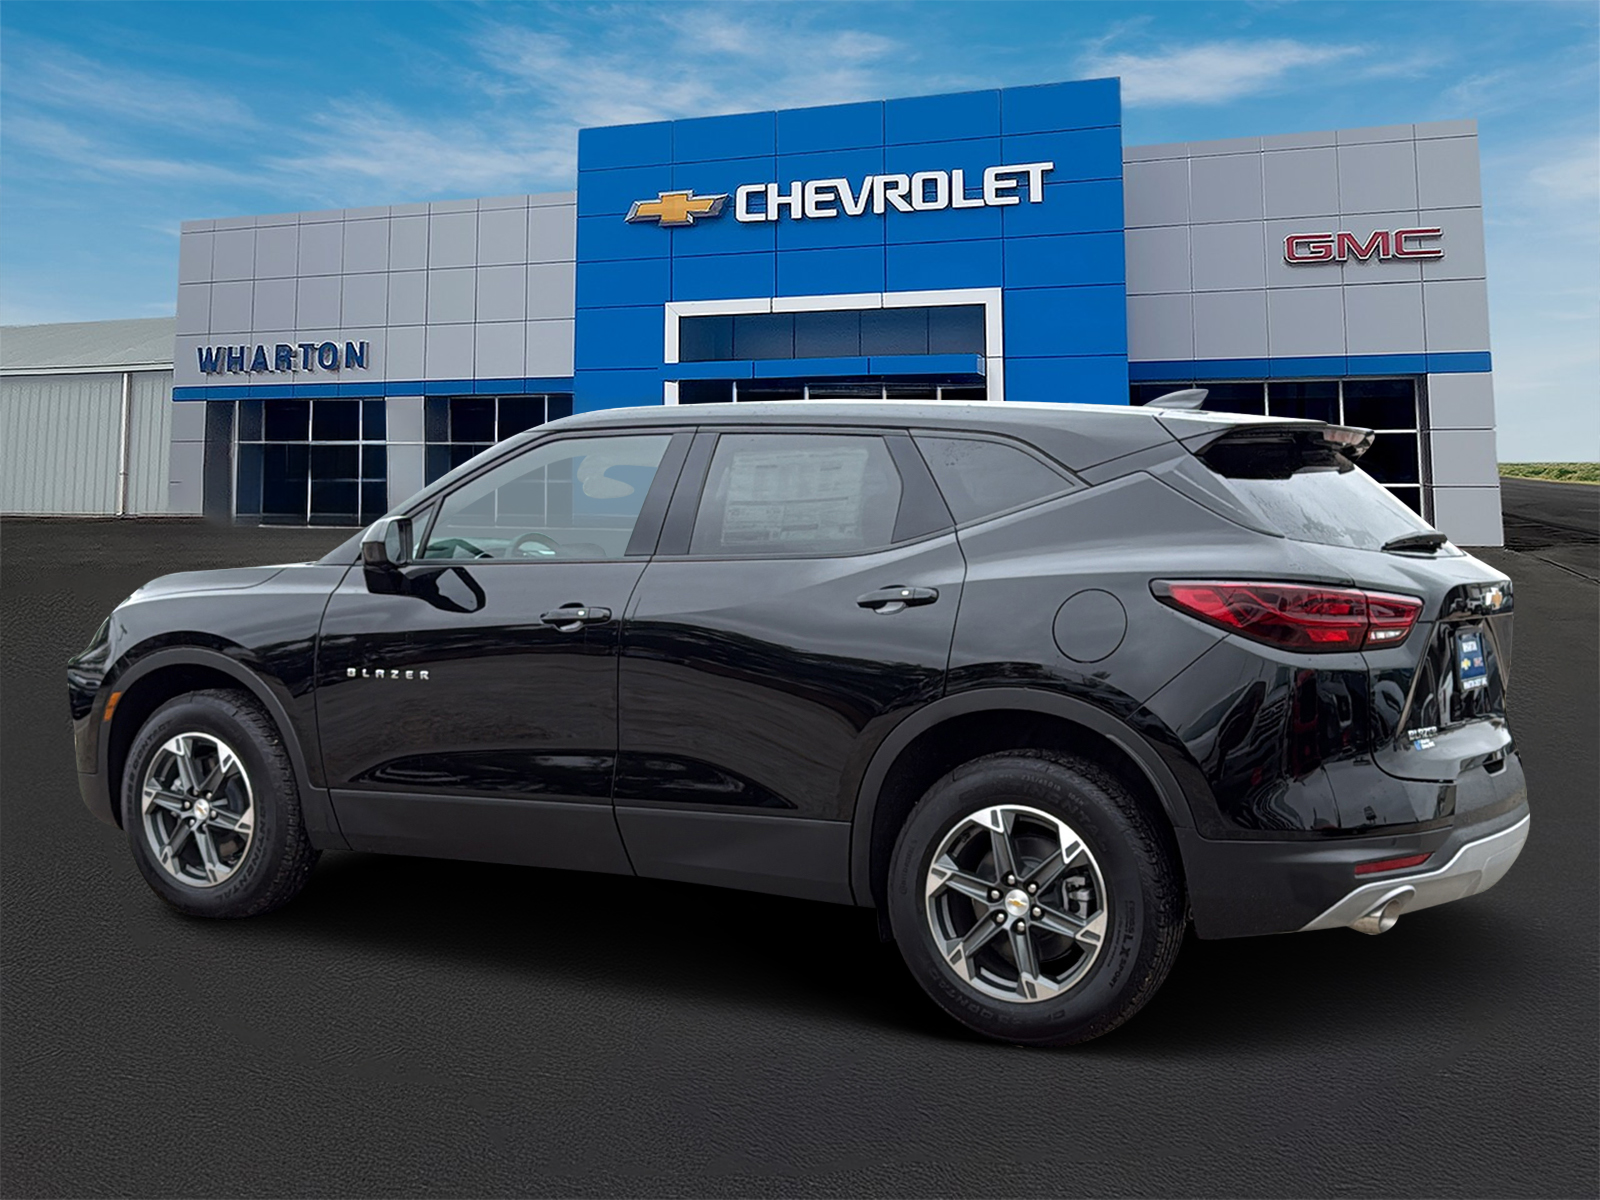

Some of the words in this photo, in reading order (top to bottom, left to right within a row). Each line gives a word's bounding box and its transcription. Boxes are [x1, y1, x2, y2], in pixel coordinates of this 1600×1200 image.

[734, 162, 1054, 222] CHEVROLET
[1284, 227, 1443, 263] GMC
[197, 341, 369, 373] WHARTON
[347, 667, 429, 680] BLAZER
